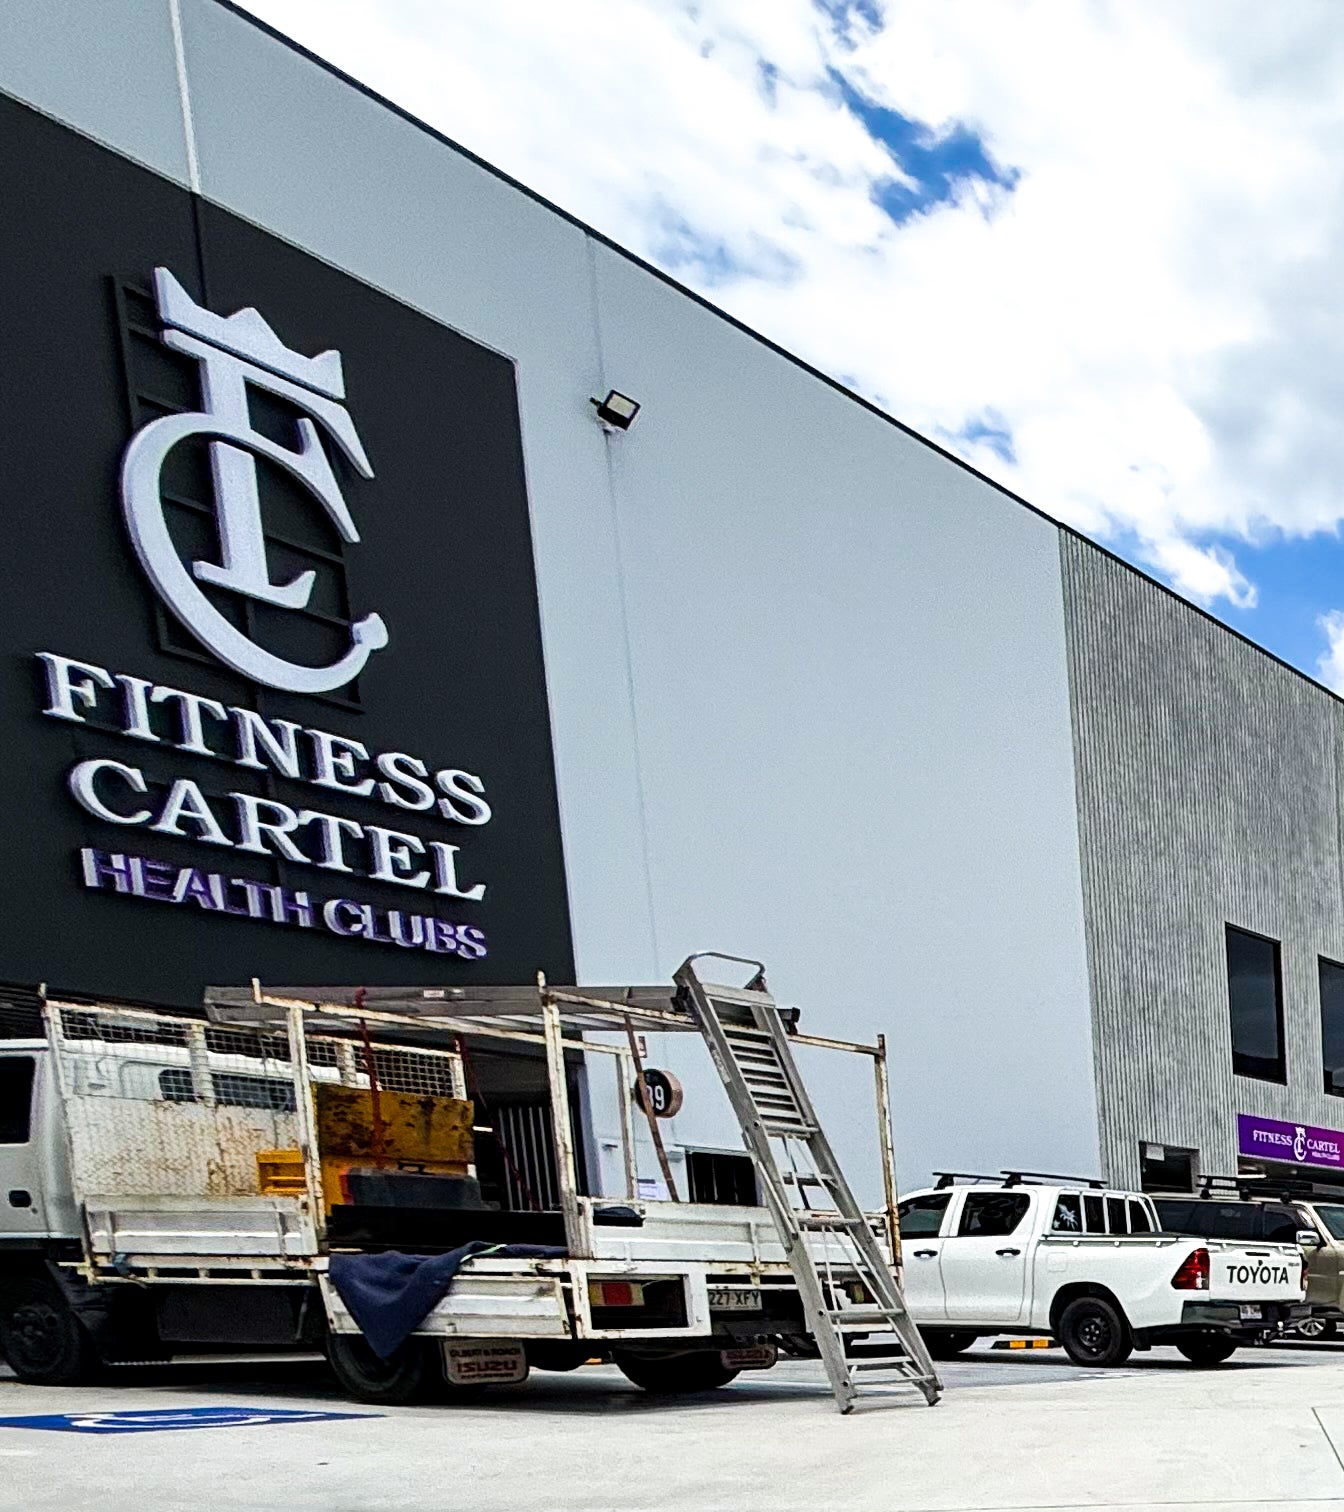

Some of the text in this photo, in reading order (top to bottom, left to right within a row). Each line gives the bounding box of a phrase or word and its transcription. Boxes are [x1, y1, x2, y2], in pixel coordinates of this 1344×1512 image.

[34, 651, 492, 826] FITNESS
[68, 759, 487, 900] CARTEL
[79, 847, 488, 960] HEALTH CLUBS
[1253, 1130, 1292, 1146] FITNESS
[1306, 1138, 1341, 1154] CARTEL
[1226, 1265, 1289, 1285] TOYOTA
[457, 1360, 517, 1373] ISUZU
